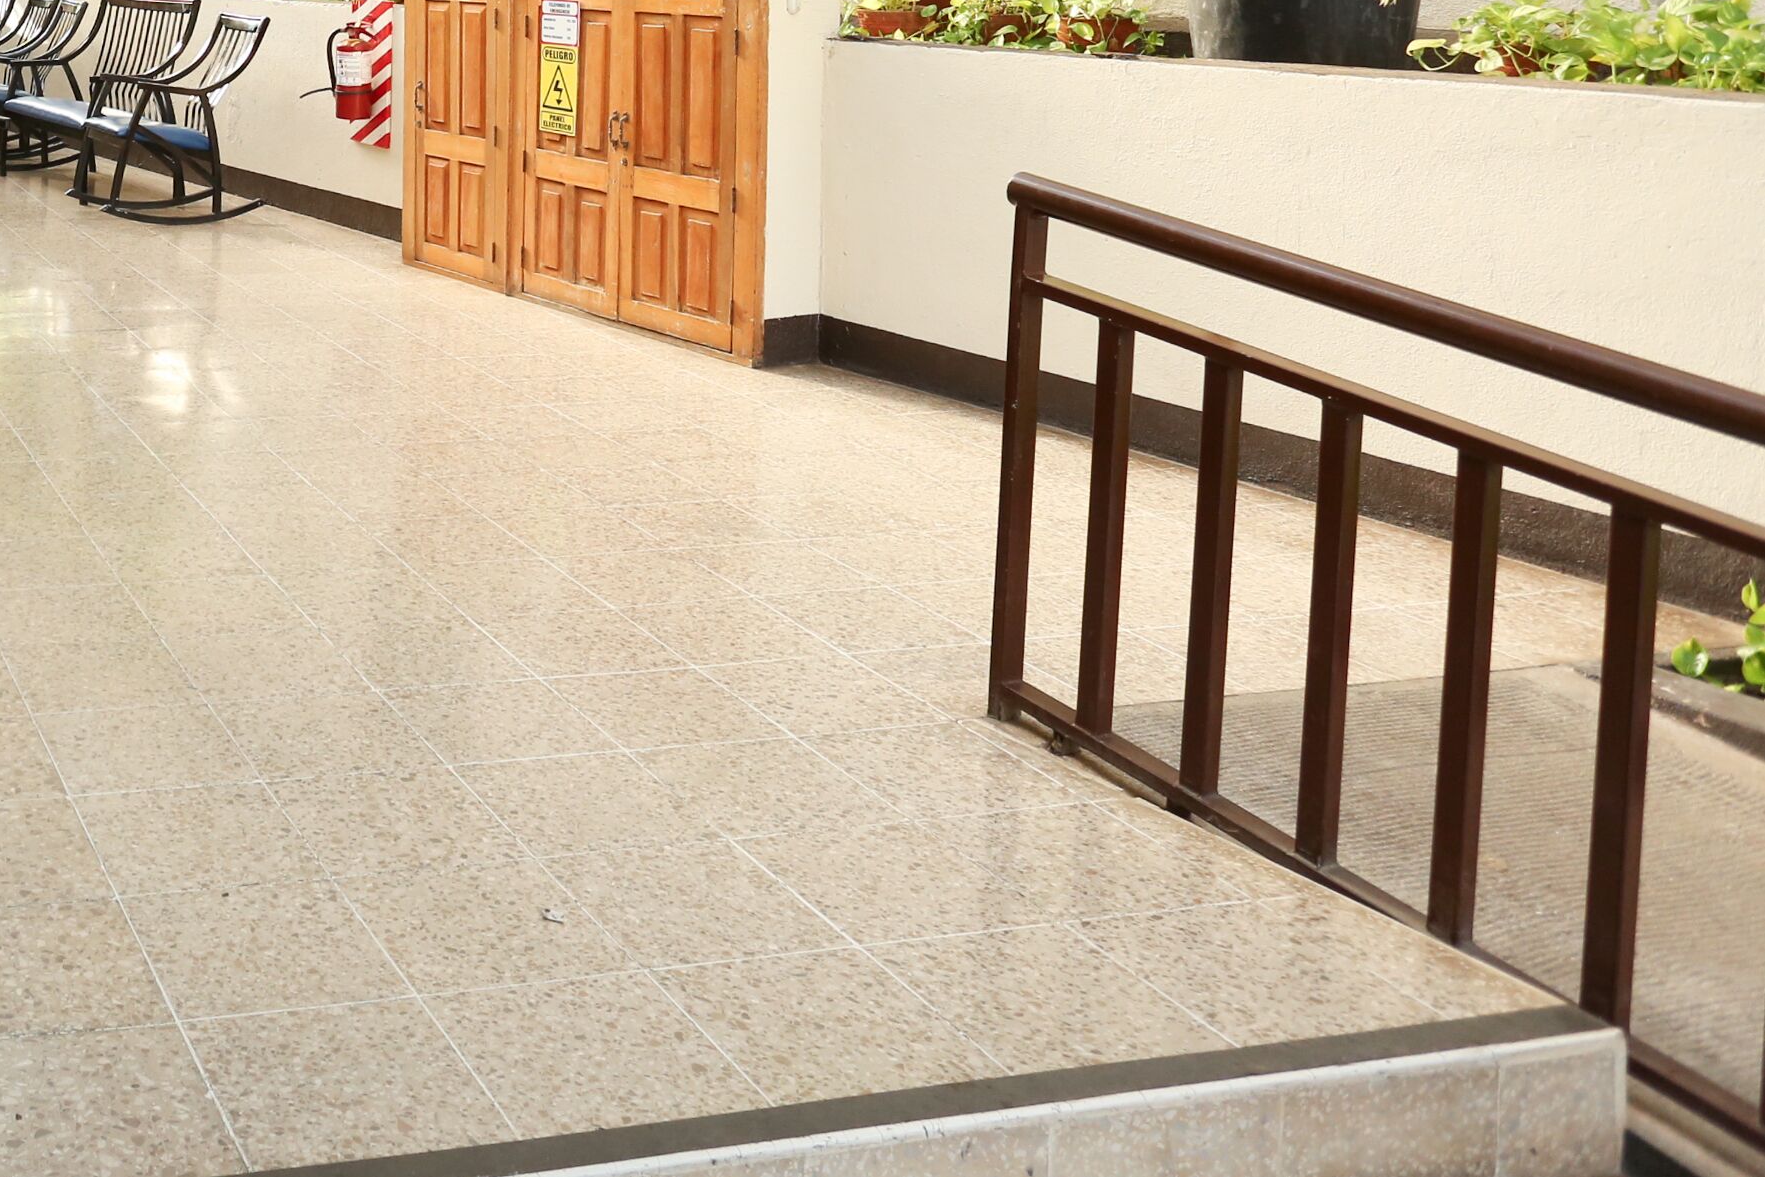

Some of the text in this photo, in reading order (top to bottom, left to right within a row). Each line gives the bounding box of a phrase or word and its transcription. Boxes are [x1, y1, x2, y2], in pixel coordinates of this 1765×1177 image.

[544, 49, 574, 62] PELIGRO
[549, 114, 566, 123] PANEL
[543, 120, 572, 132] ELECTRICO
